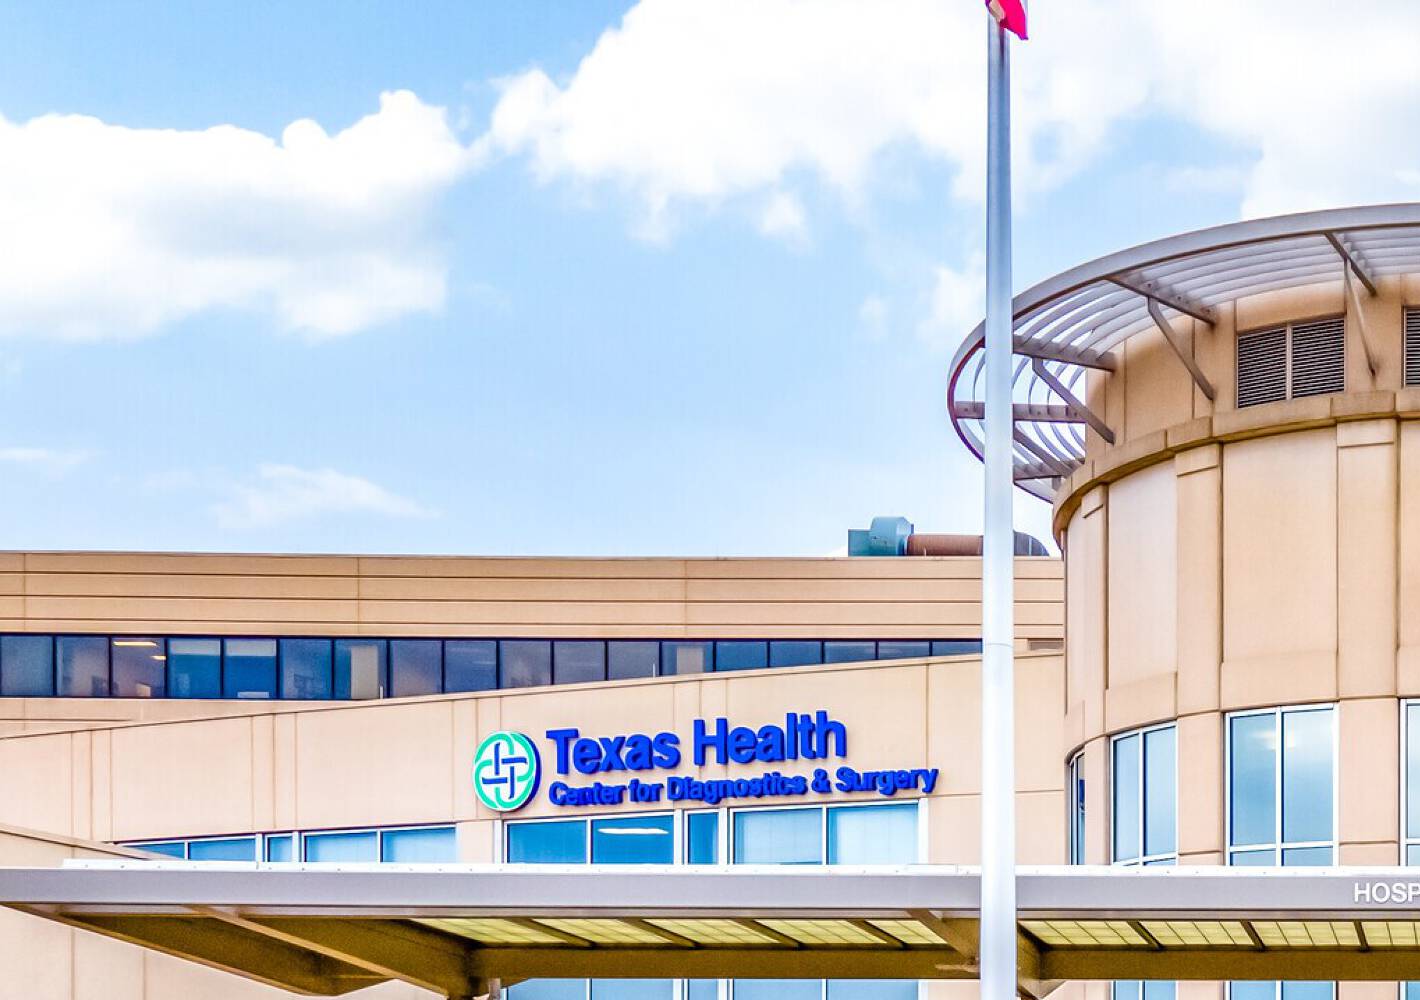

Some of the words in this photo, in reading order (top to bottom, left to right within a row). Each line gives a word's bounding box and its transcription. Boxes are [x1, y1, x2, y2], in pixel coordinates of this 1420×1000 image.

[546, 728, 682, 775] Texas
[693, 709, 847, 767] Health
[548, 778, 627, 806] Center
[628, 775, 663, 801] for
[667, 770, 807, 805] Diagnostics
[812, 769, 831, 793] &
[836, 766, 940, 796] Surgery
